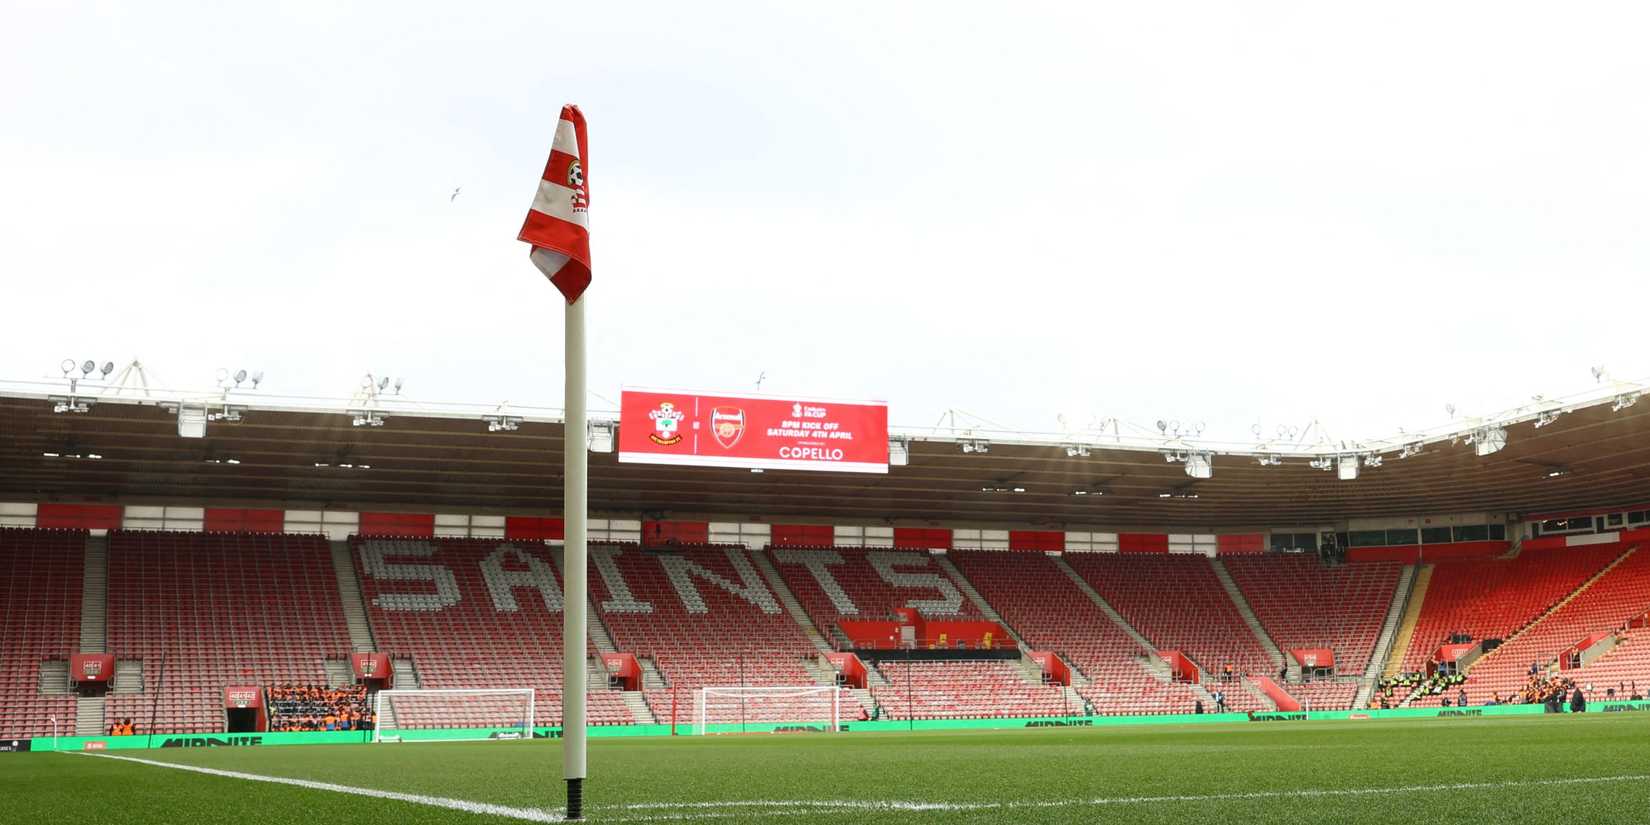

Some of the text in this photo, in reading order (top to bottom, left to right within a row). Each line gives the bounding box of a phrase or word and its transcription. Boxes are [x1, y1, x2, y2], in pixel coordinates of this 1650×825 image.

[802, 421, 822, 430] KICK
[823, 422, 839, 431] OFF
[767, 428, 854, 440] SATURDAY 4TH APRIL
[779, 446, 843, 460] COPELLO
[358, 540, 962, 615] SAINTS
[162, 737, 262, 748] MIDNITE
